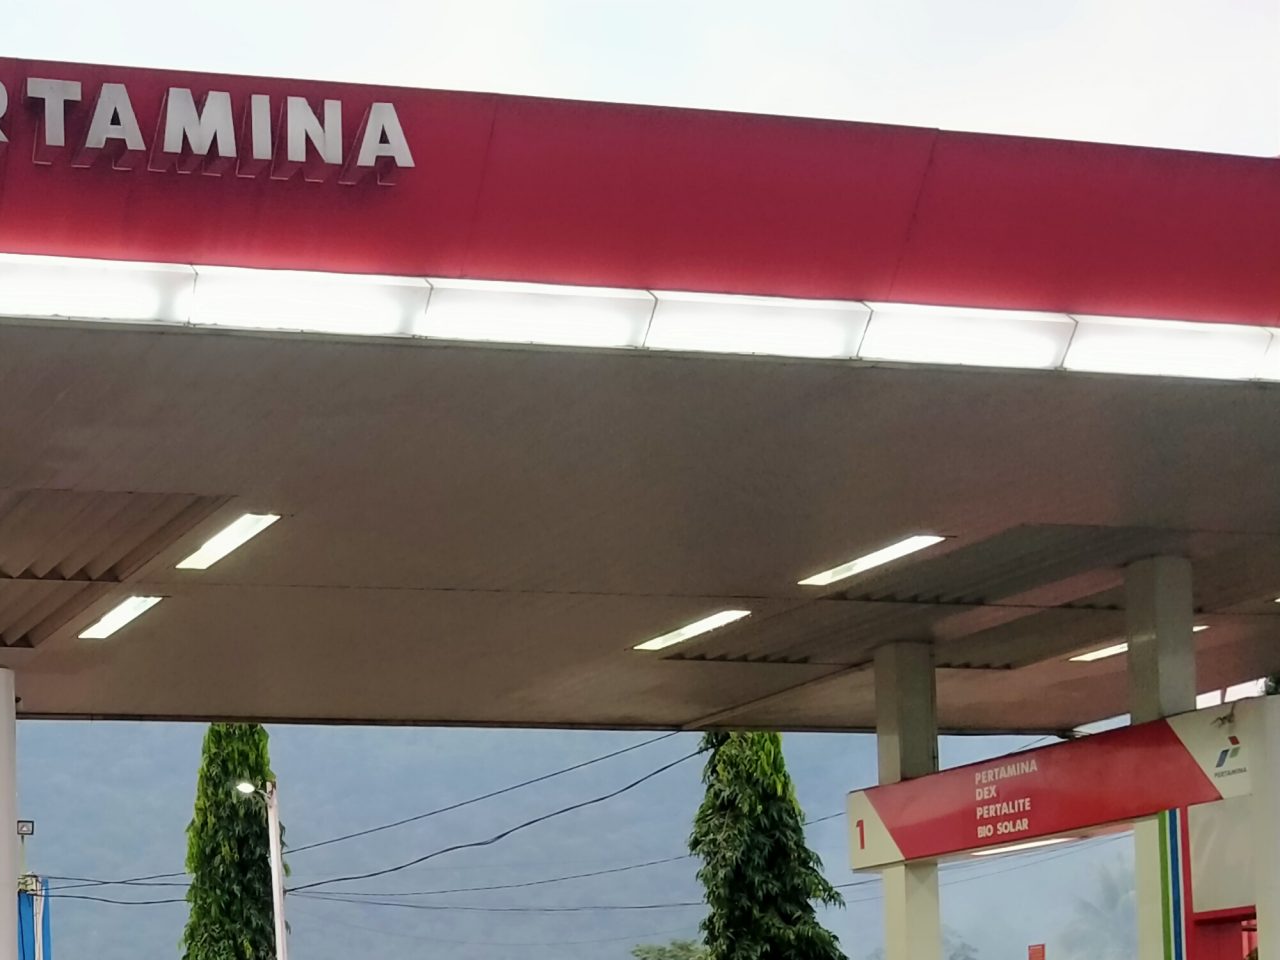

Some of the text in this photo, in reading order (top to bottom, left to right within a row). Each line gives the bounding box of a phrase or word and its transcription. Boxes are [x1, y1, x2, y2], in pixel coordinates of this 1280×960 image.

[975, 759, 1038, 786] PERTAMINA
[976, 785, 997, 801] DEX
[976, 798, 1032, 820] PERTALITE
[855, 819, 865, 850] 1
[977, 818, 1029, 838] BIO SOLAR
